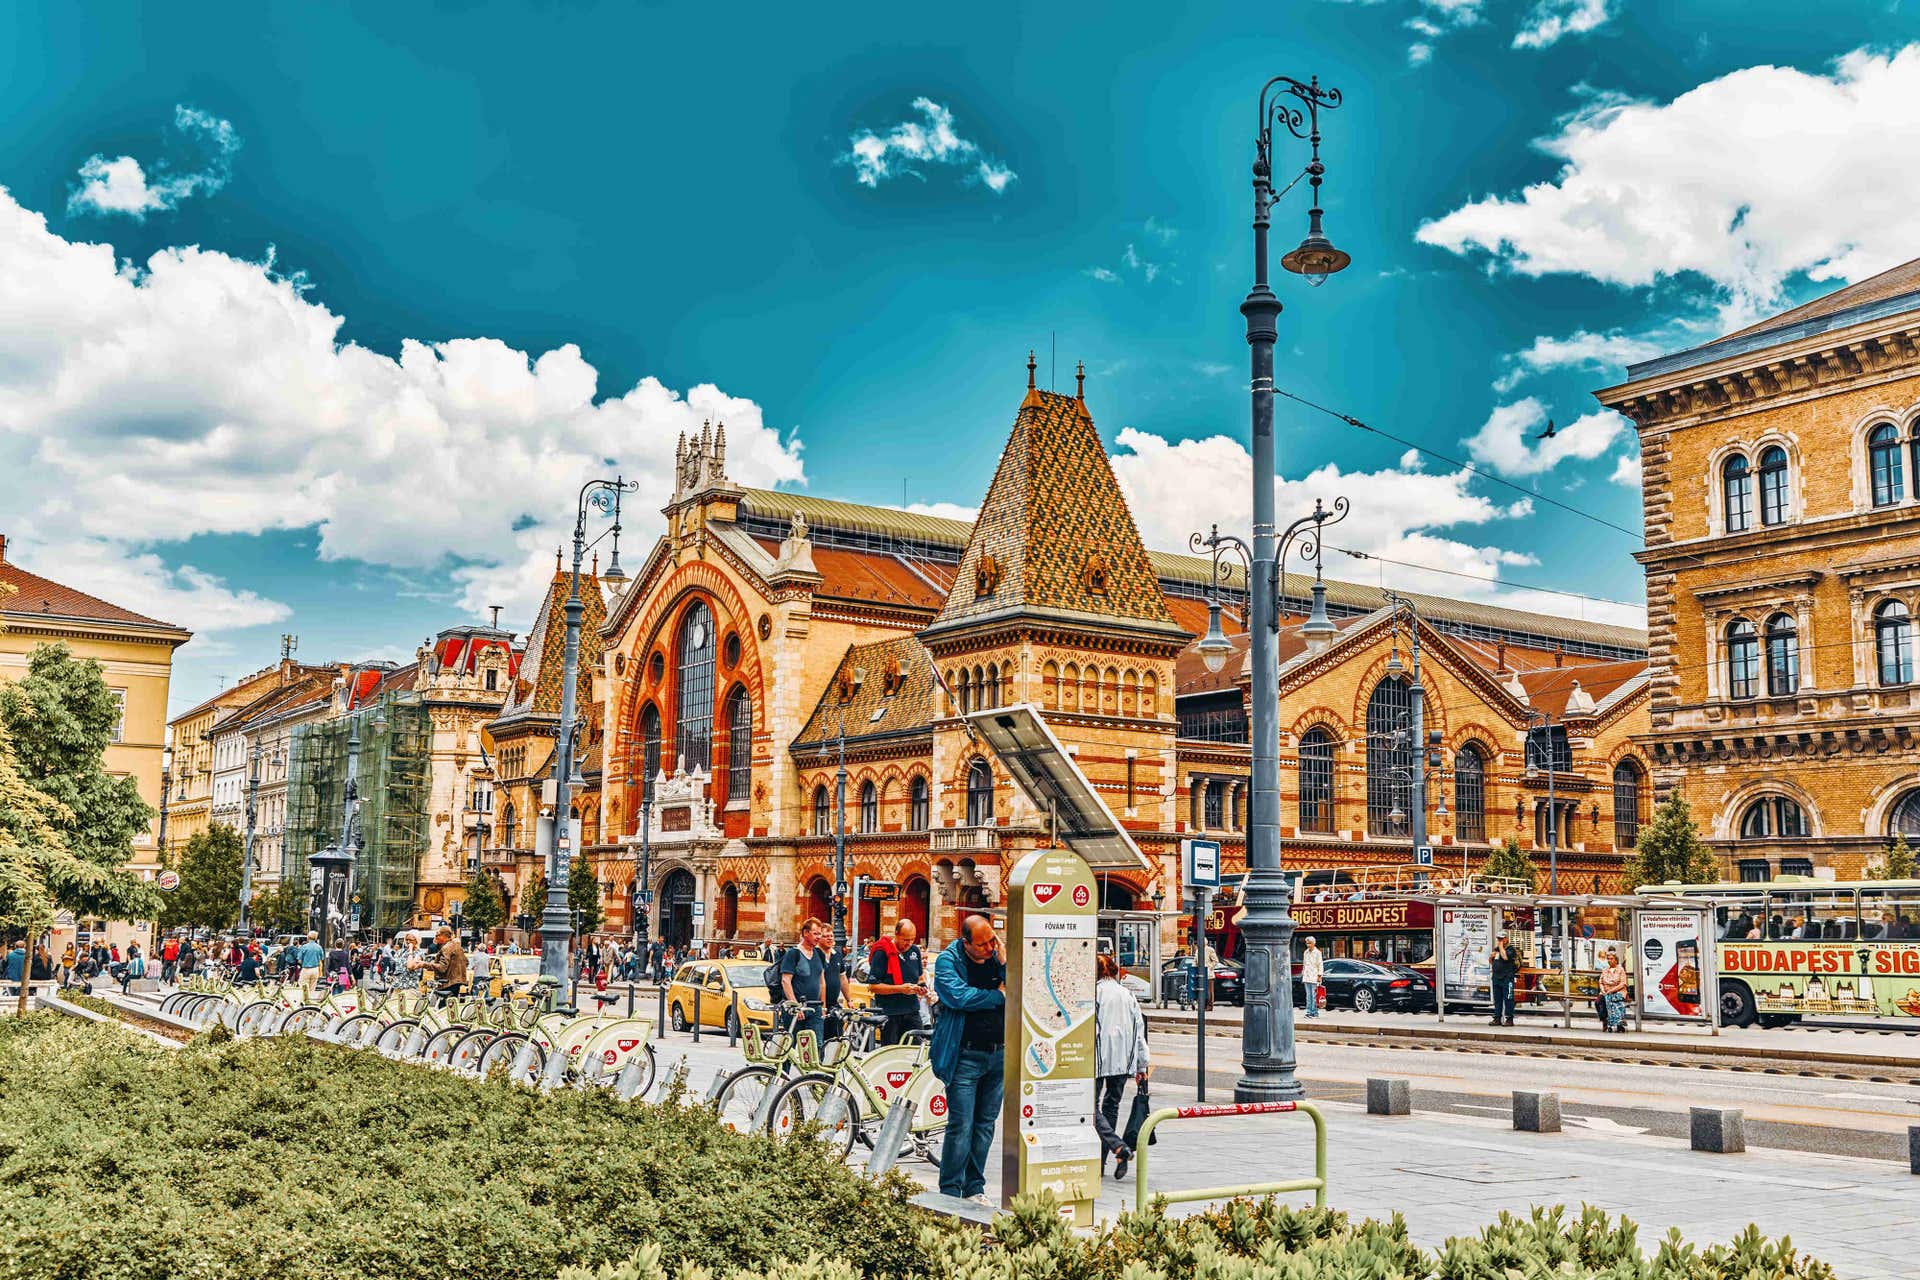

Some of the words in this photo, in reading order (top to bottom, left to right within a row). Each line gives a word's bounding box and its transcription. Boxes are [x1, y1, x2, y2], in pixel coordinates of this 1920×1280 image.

[1422, 850, 1429, 862] P
[1036, 886, 1052, 895] MOL
[1337, 907, 1408, 924] BUDAPEST
[1724, 950, 1854, 972] BUDAPEST
